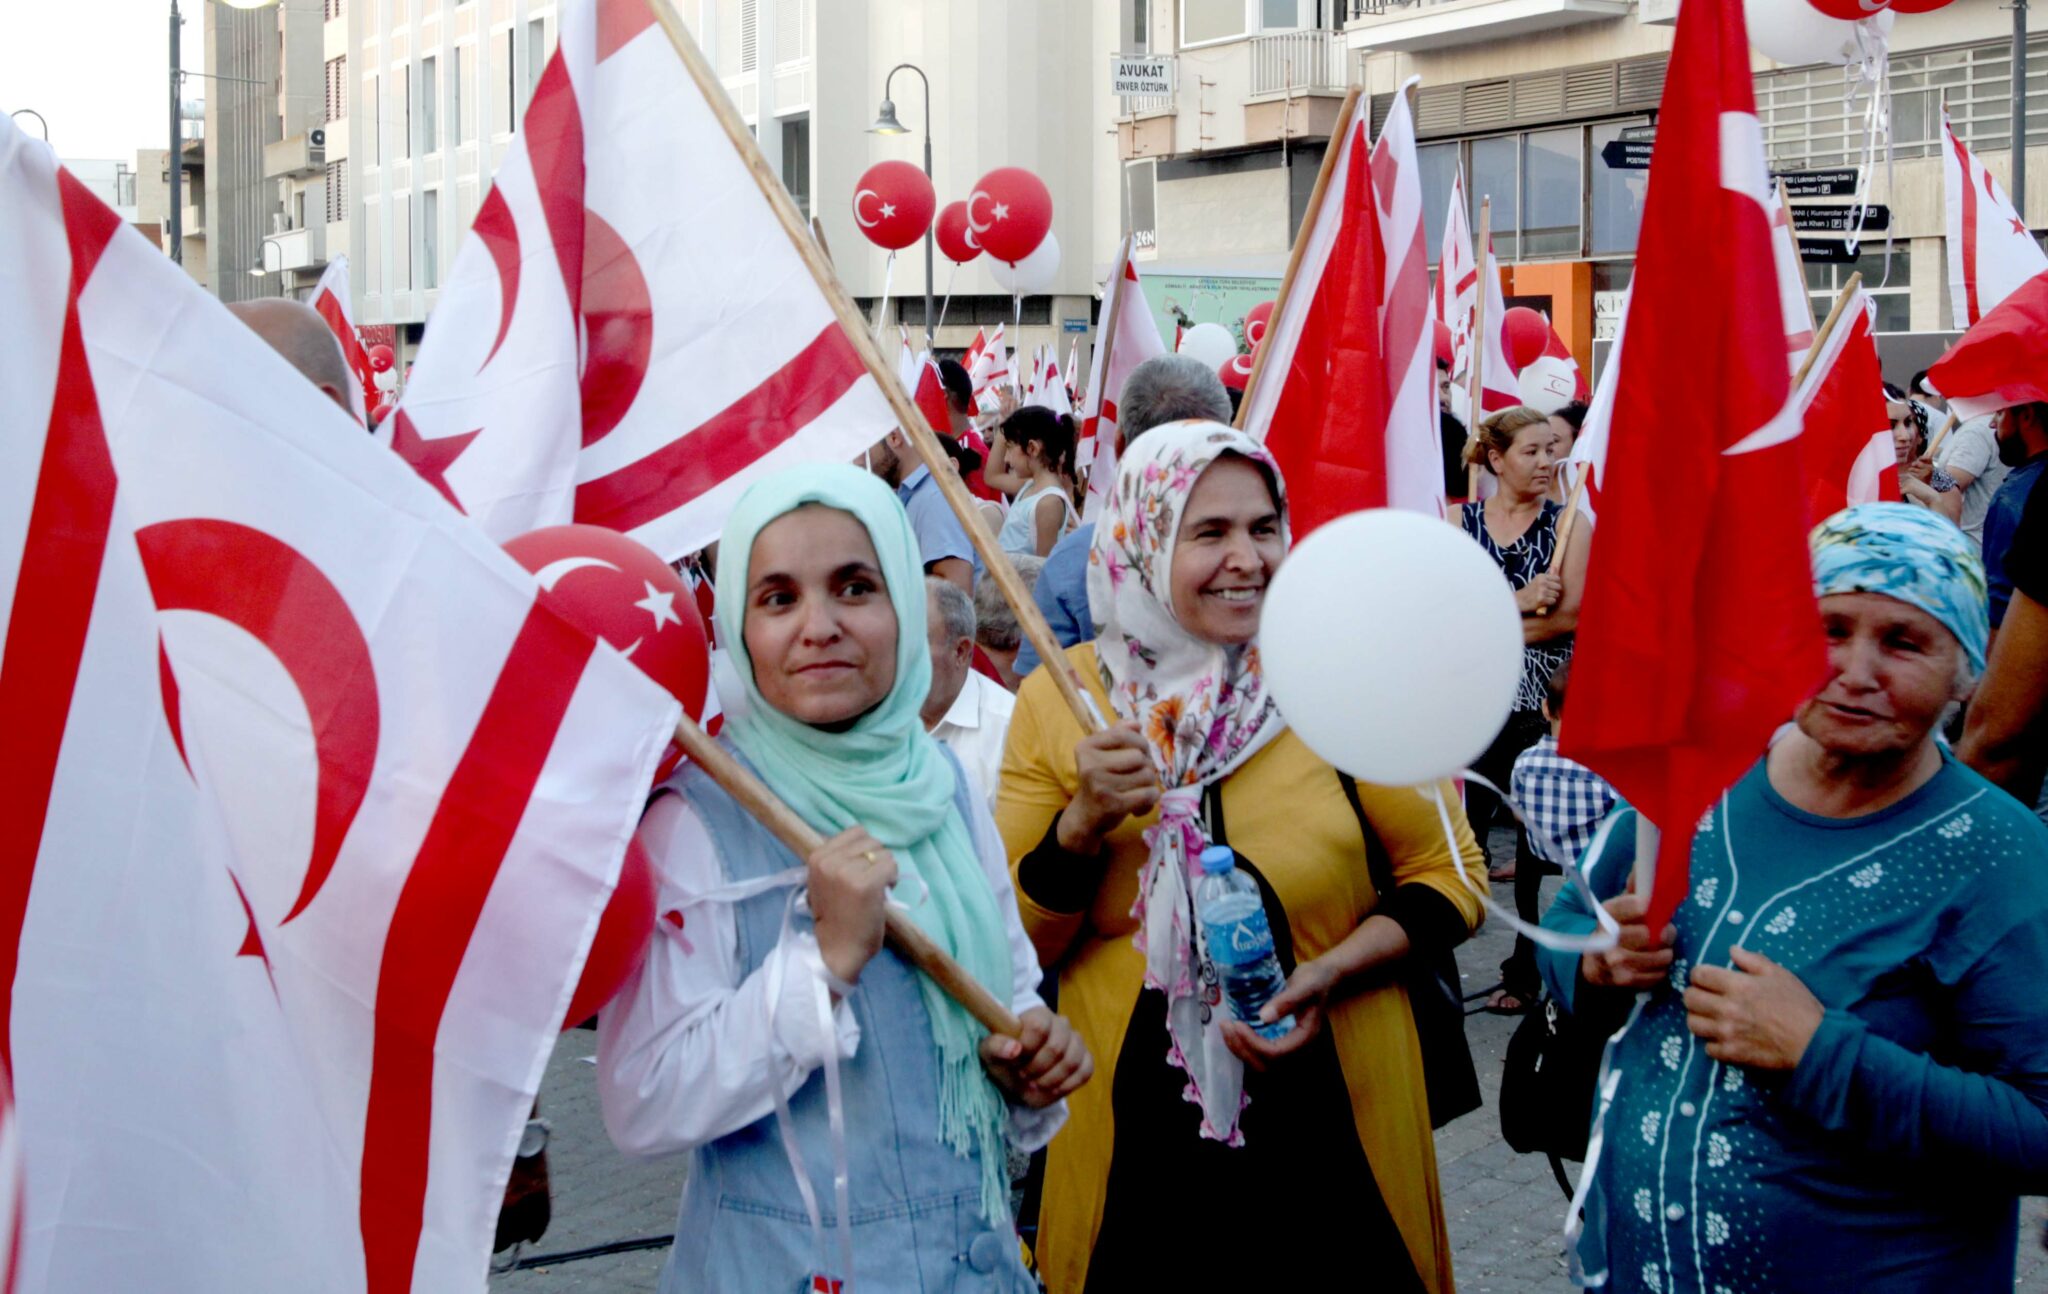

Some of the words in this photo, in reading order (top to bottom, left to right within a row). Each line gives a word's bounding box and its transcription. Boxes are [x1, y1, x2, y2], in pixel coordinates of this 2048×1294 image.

[1120, 64, 1164, 77] AVUKAT
[1116, 81, 1139, 91] ENVER
[1140, 80, 1168, 92] ÖZTÜRK
